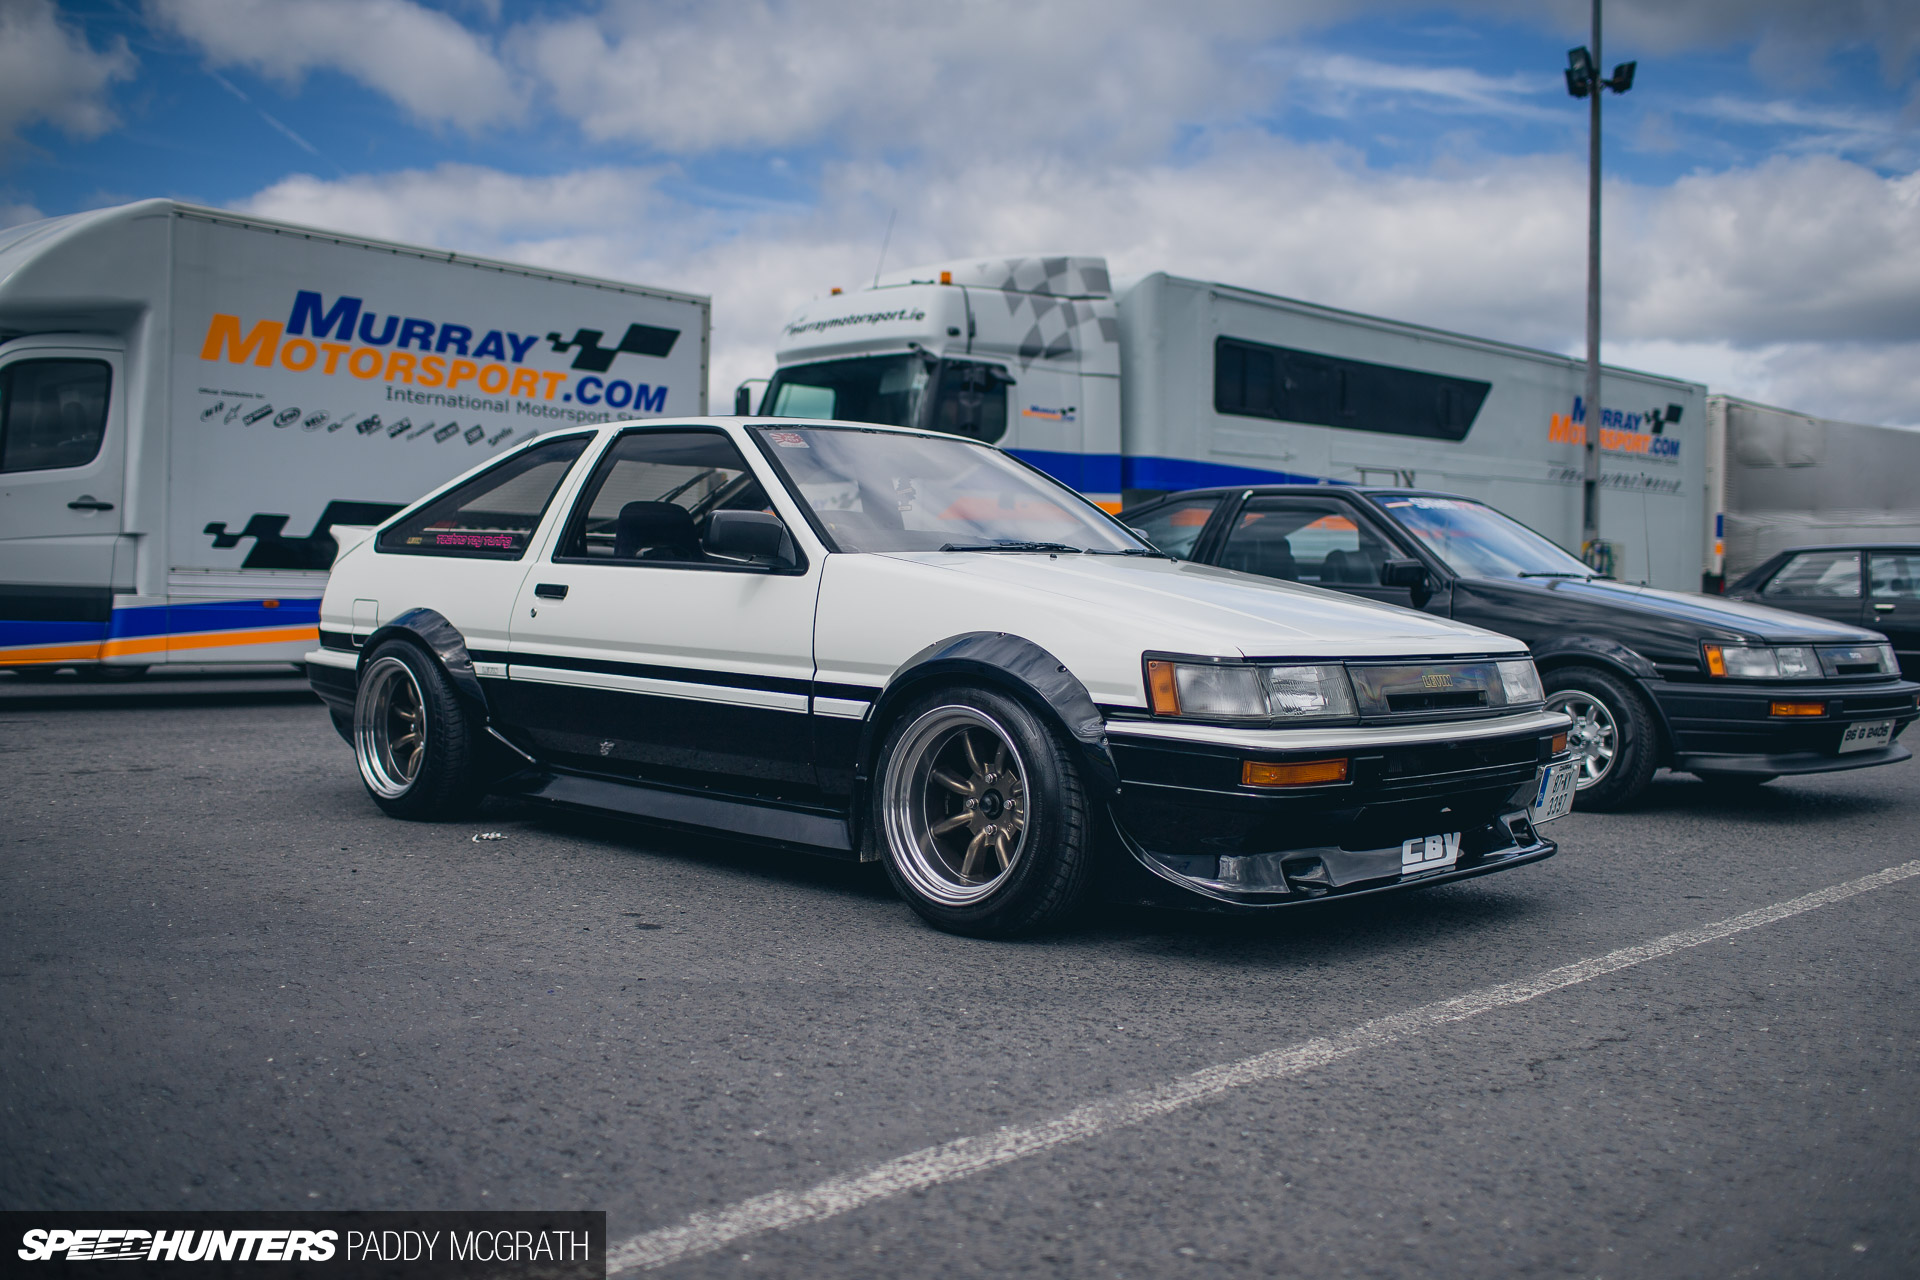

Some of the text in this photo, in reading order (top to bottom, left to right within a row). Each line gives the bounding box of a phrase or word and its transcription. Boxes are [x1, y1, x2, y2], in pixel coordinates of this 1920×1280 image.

[286, 290, 539, 363] MURRAY
[200, 313, 668, 413] MOTORSPORT.COM
[386, 385, 609, 424] International Motorsport
[1573, 396, 1642, 432] MRRAY
[1548, 412, 1680, 457] MOTRSPORT.COM
[1421, 674, 1453, 688] LEVIN
[1402, 832, 1461, 874] CBY
